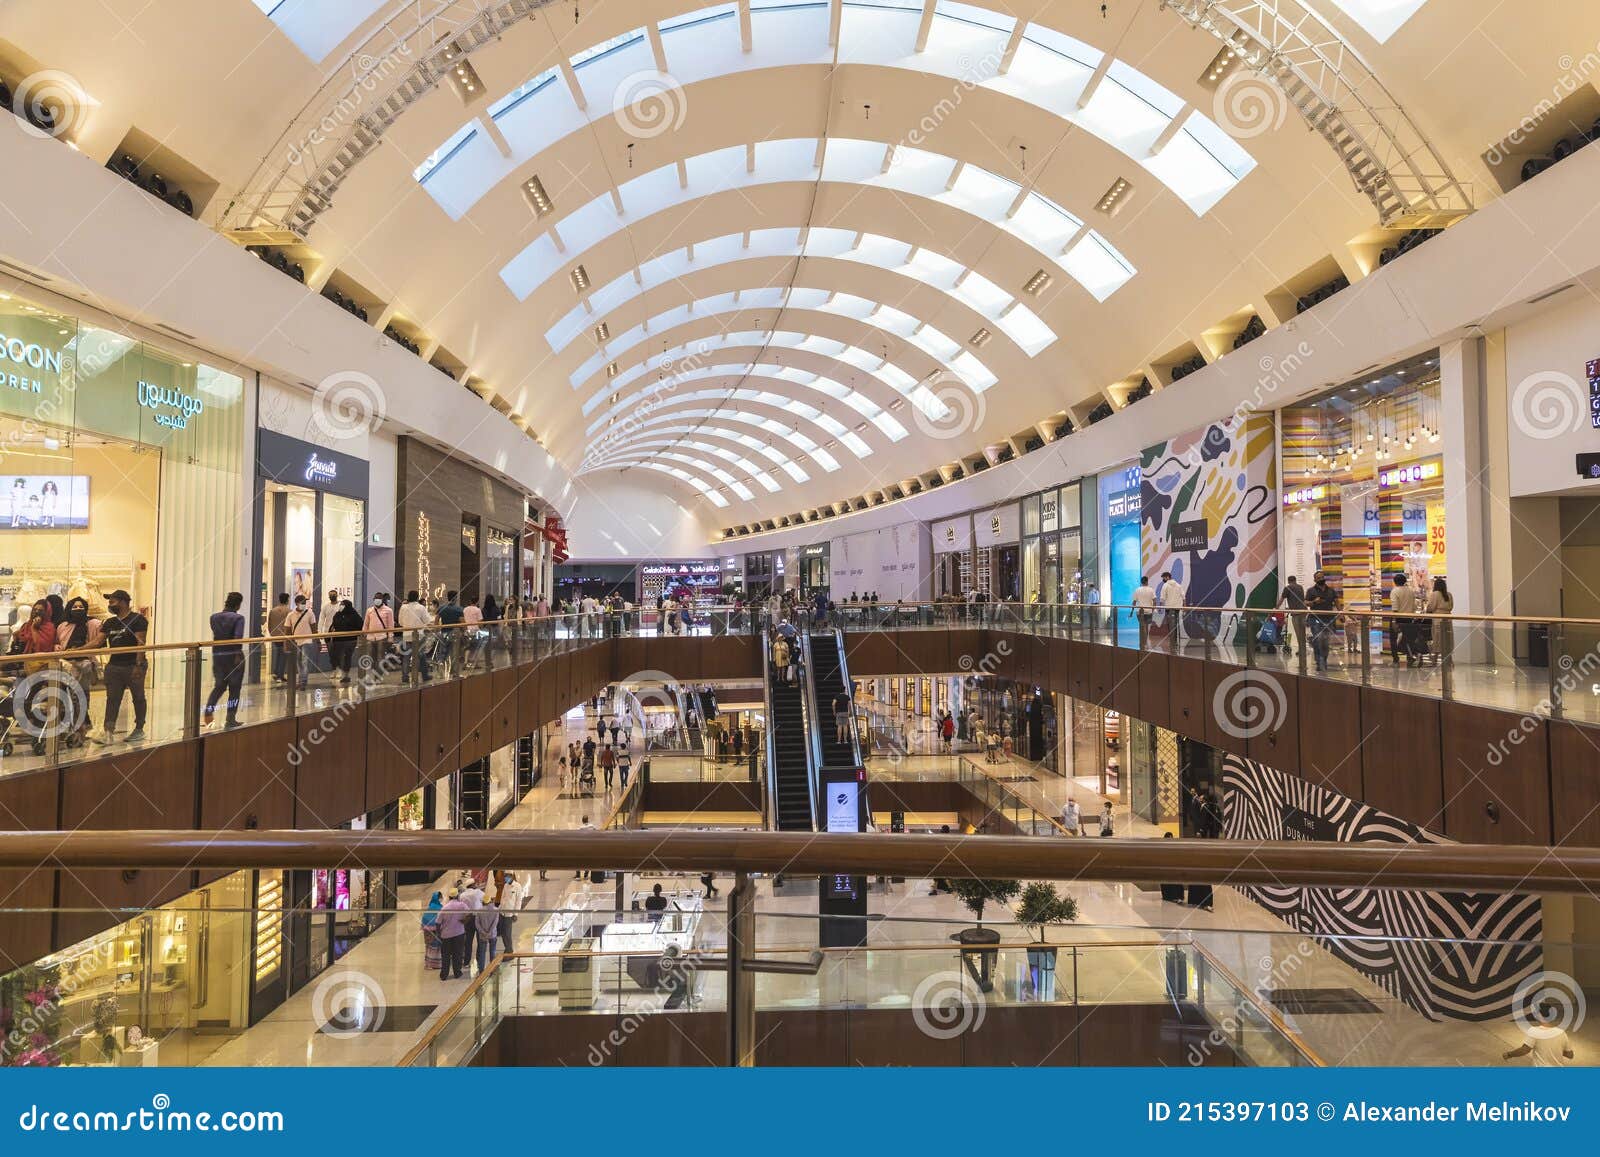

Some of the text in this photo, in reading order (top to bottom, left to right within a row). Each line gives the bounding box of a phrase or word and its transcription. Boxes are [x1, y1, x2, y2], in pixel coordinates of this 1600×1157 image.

[1432, 526, 1444, 539] 30
[1432, 541, 1445, 554] 70
[1304, 818, 1315, 830] THE
